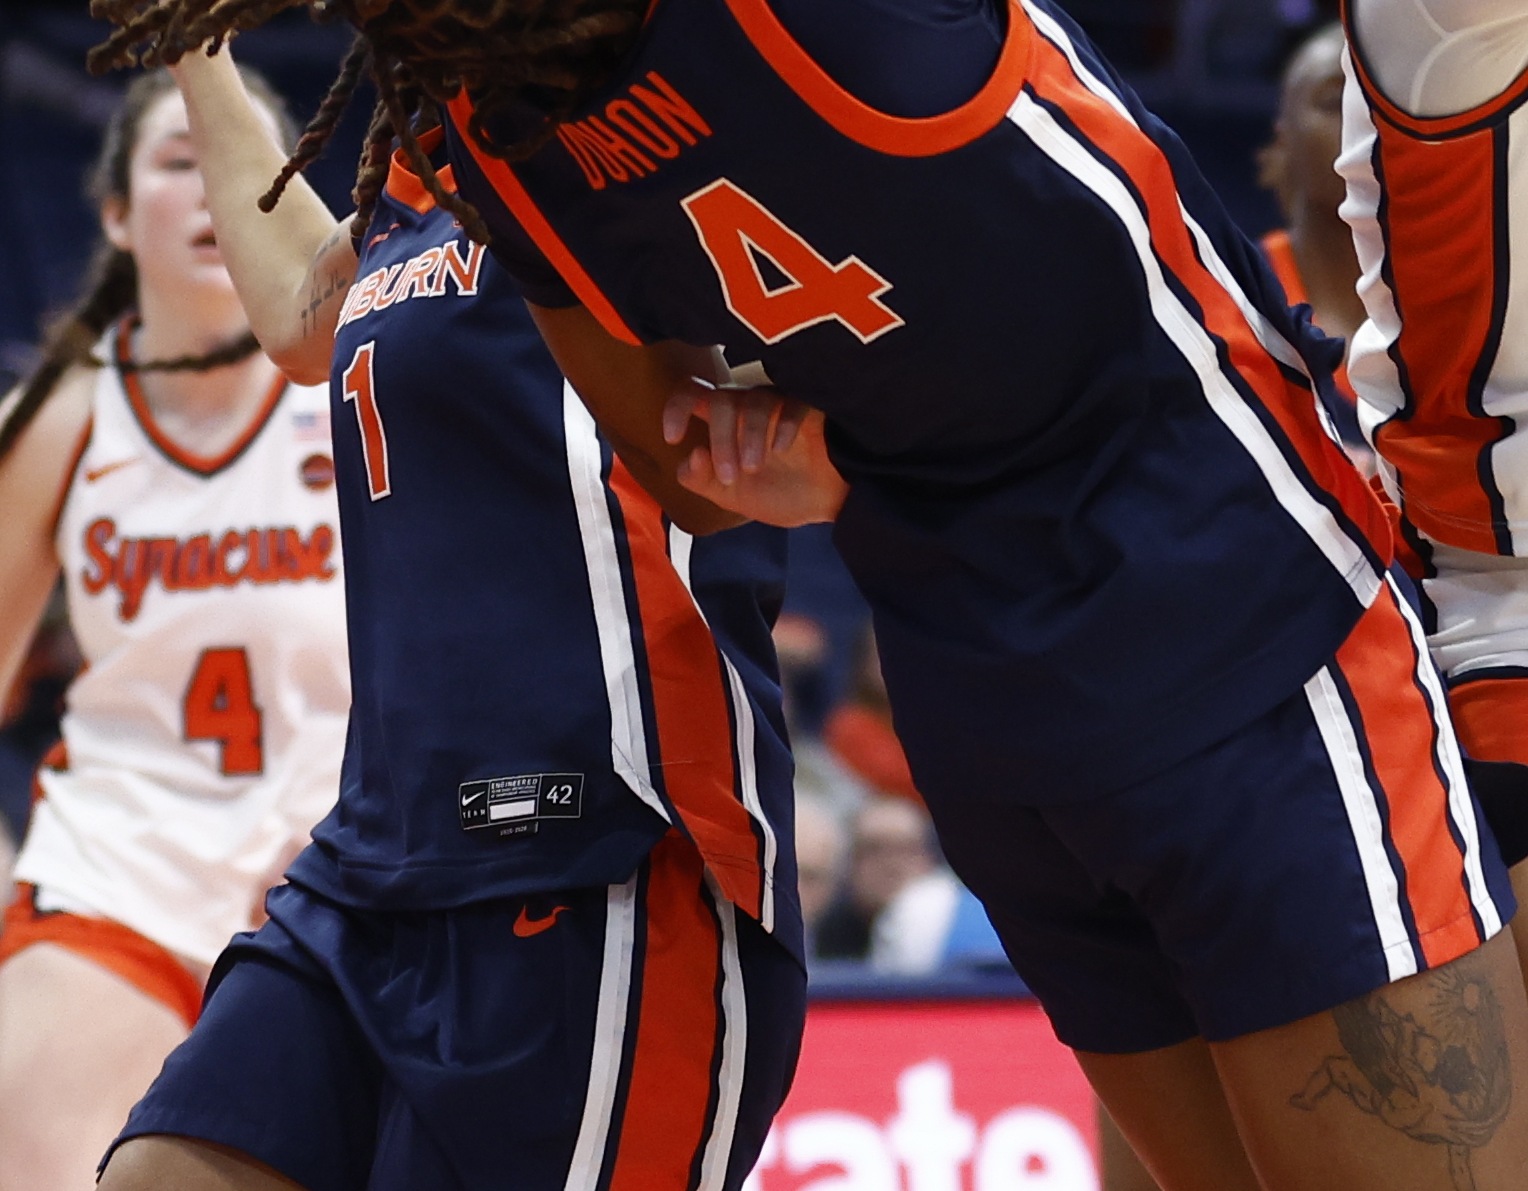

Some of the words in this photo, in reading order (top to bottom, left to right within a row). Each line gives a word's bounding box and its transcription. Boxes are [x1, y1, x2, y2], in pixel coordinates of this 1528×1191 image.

[680, 176, 906, 345] 4
[343, 340, 392, 502] 1
[83, 517, 337, 622] Syracuse
[181, 645, 264, 777] 4
[546, 784, 573, 805] 42
